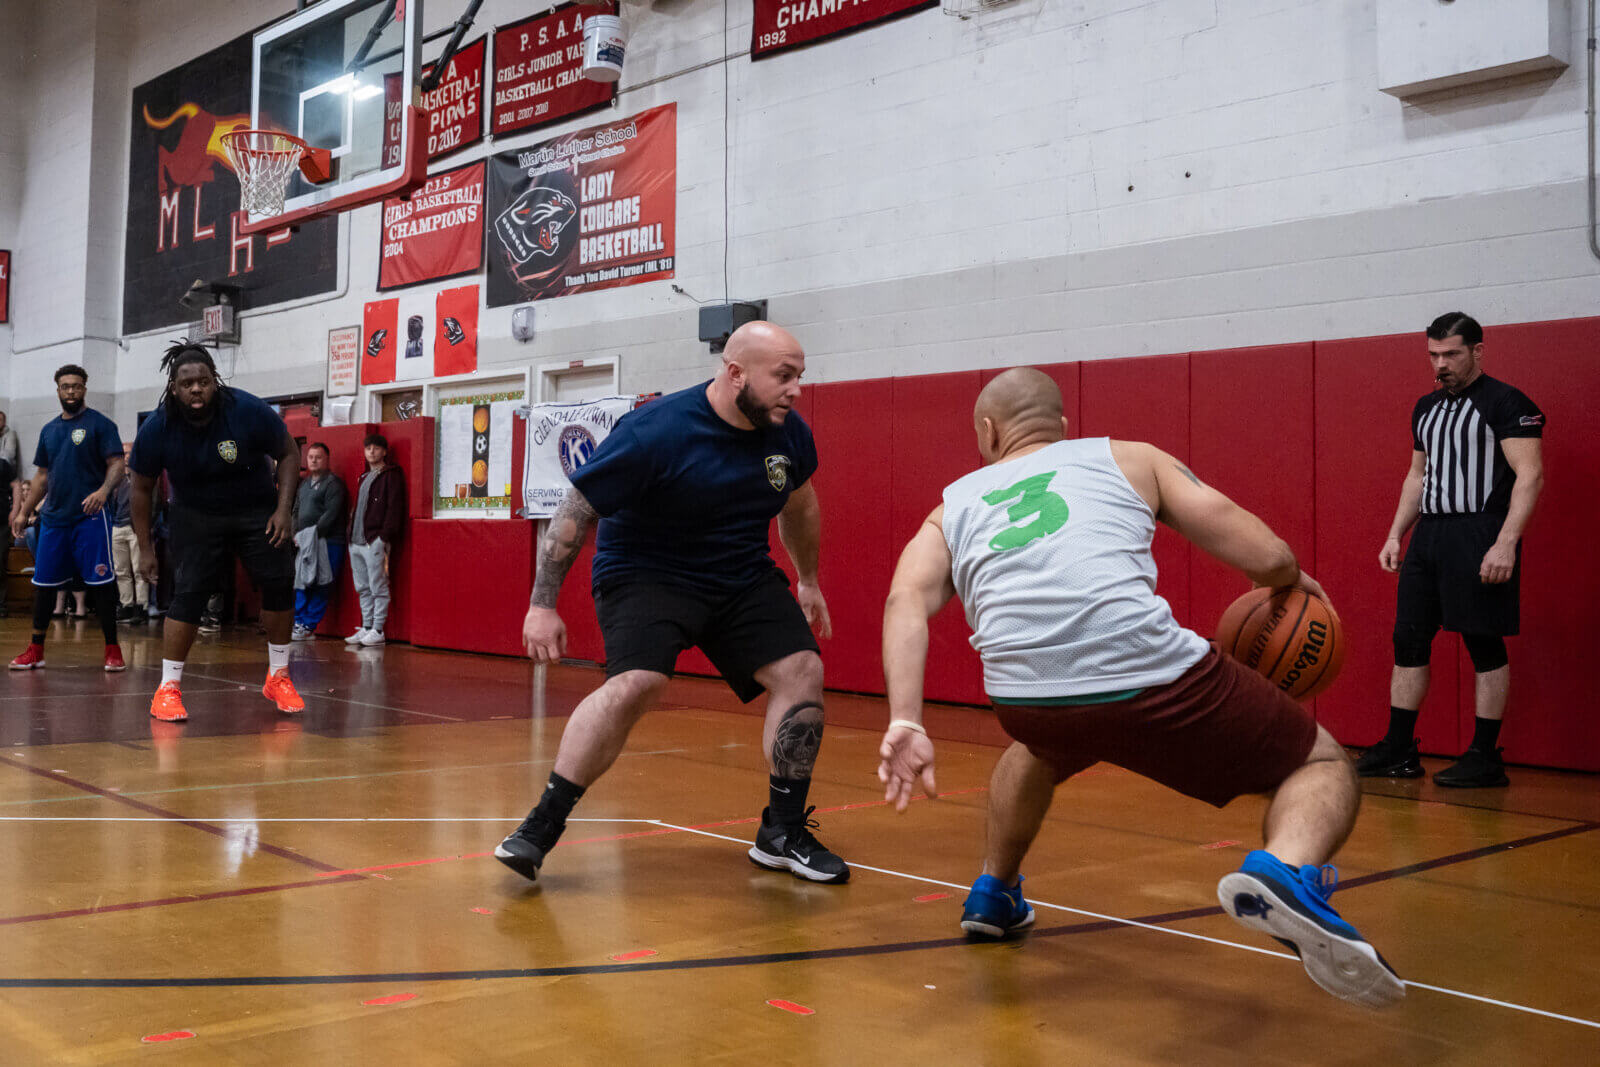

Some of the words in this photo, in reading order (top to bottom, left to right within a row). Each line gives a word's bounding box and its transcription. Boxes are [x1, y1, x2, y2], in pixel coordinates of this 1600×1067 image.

[759, 30, 787, 49] 1992
[497, 63, 525, 83] GIRLS
[527, 50, 563, 75] JUNIOR
[496, 76, 554, 106] BASKETBALL
[499, 111, 514, 126] 2001
[438, 125, 462, 152] 2012
[518, 147, 554, 169] Martin
[556, 137, 594, 159] Luther
[595, 122, 637, 149] School
[581, 170, 615, 202] LADY
[384, 201, 413, 228] GIRLS
[416, 183, 482, 212] BASKETBALL
[580, 195, 640, 234] COUGARS
[388, 205, 478, 241] CHAMPIONS
[384, 241, 404, 258] 2004
[579, 223, 664, 265] BASKETBALL
[565, 273, 586, 287] Thank
[586, 270, 599, 283] You
[600, 267, 619, 281] David
[620, 264, 644, 278] Turner
[205, 310, 221, 334] EXIT
[534, 408, 585, 446] GLENDALE
[527, 488, 563, 498] SERVING
[981, 470, 1069, 552] 3
[1278, 620, 1328, 692] Wilson
